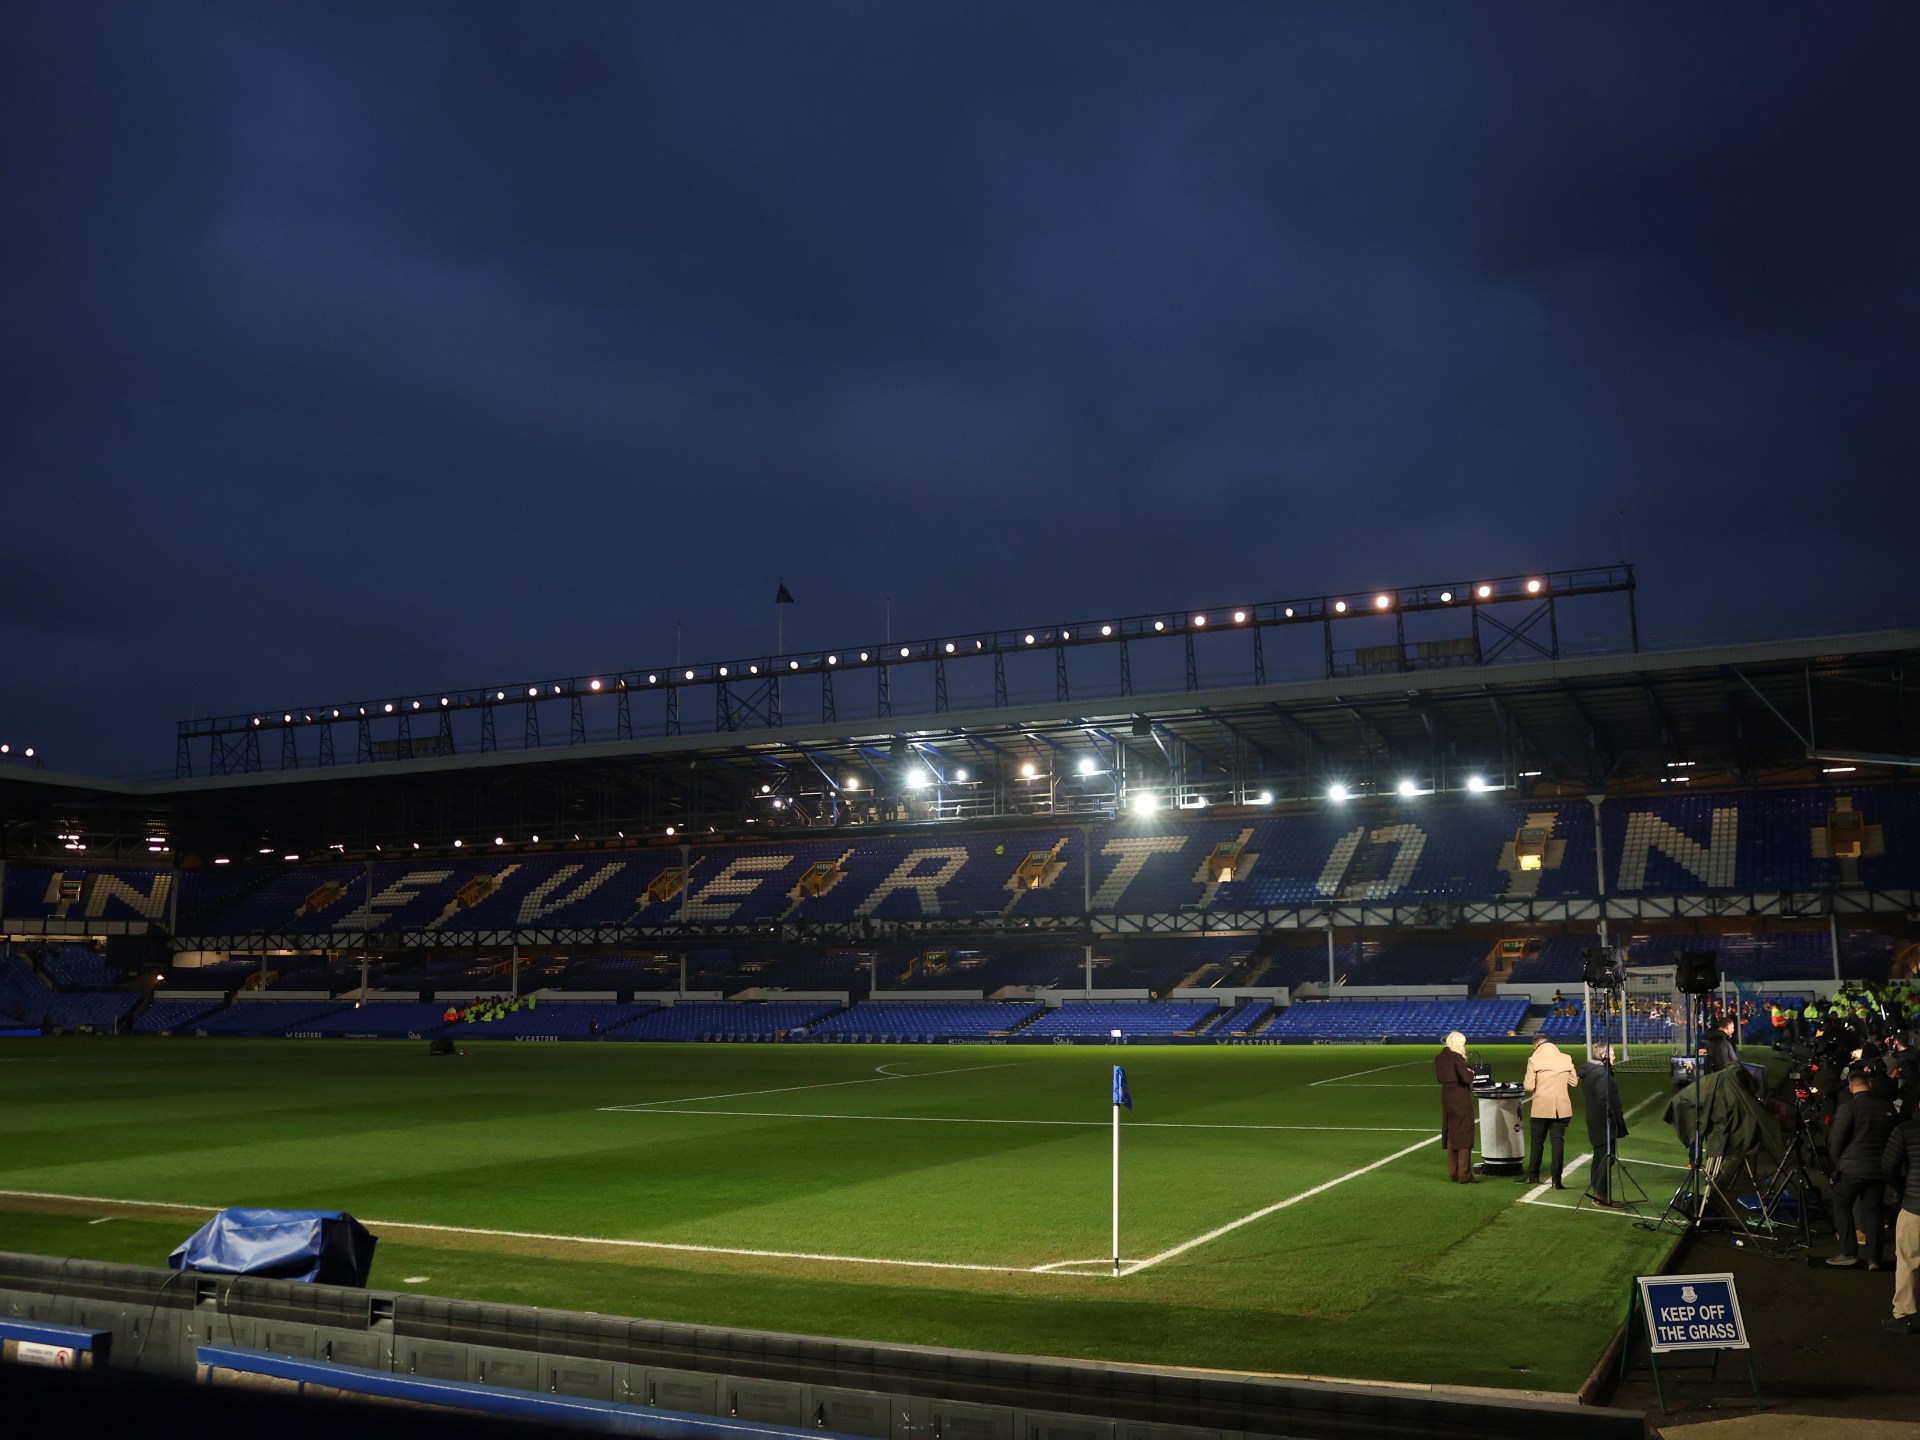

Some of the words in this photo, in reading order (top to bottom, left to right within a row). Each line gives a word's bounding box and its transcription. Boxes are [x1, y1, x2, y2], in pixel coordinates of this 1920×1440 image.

[1661, 1306, 1695, 1322] KEEP
[1699, 1305, 1725, 1320] OFF
[1658, 1326, 1687, 1341] THE
[1689, 1323, 1736, 1340] GRASS
